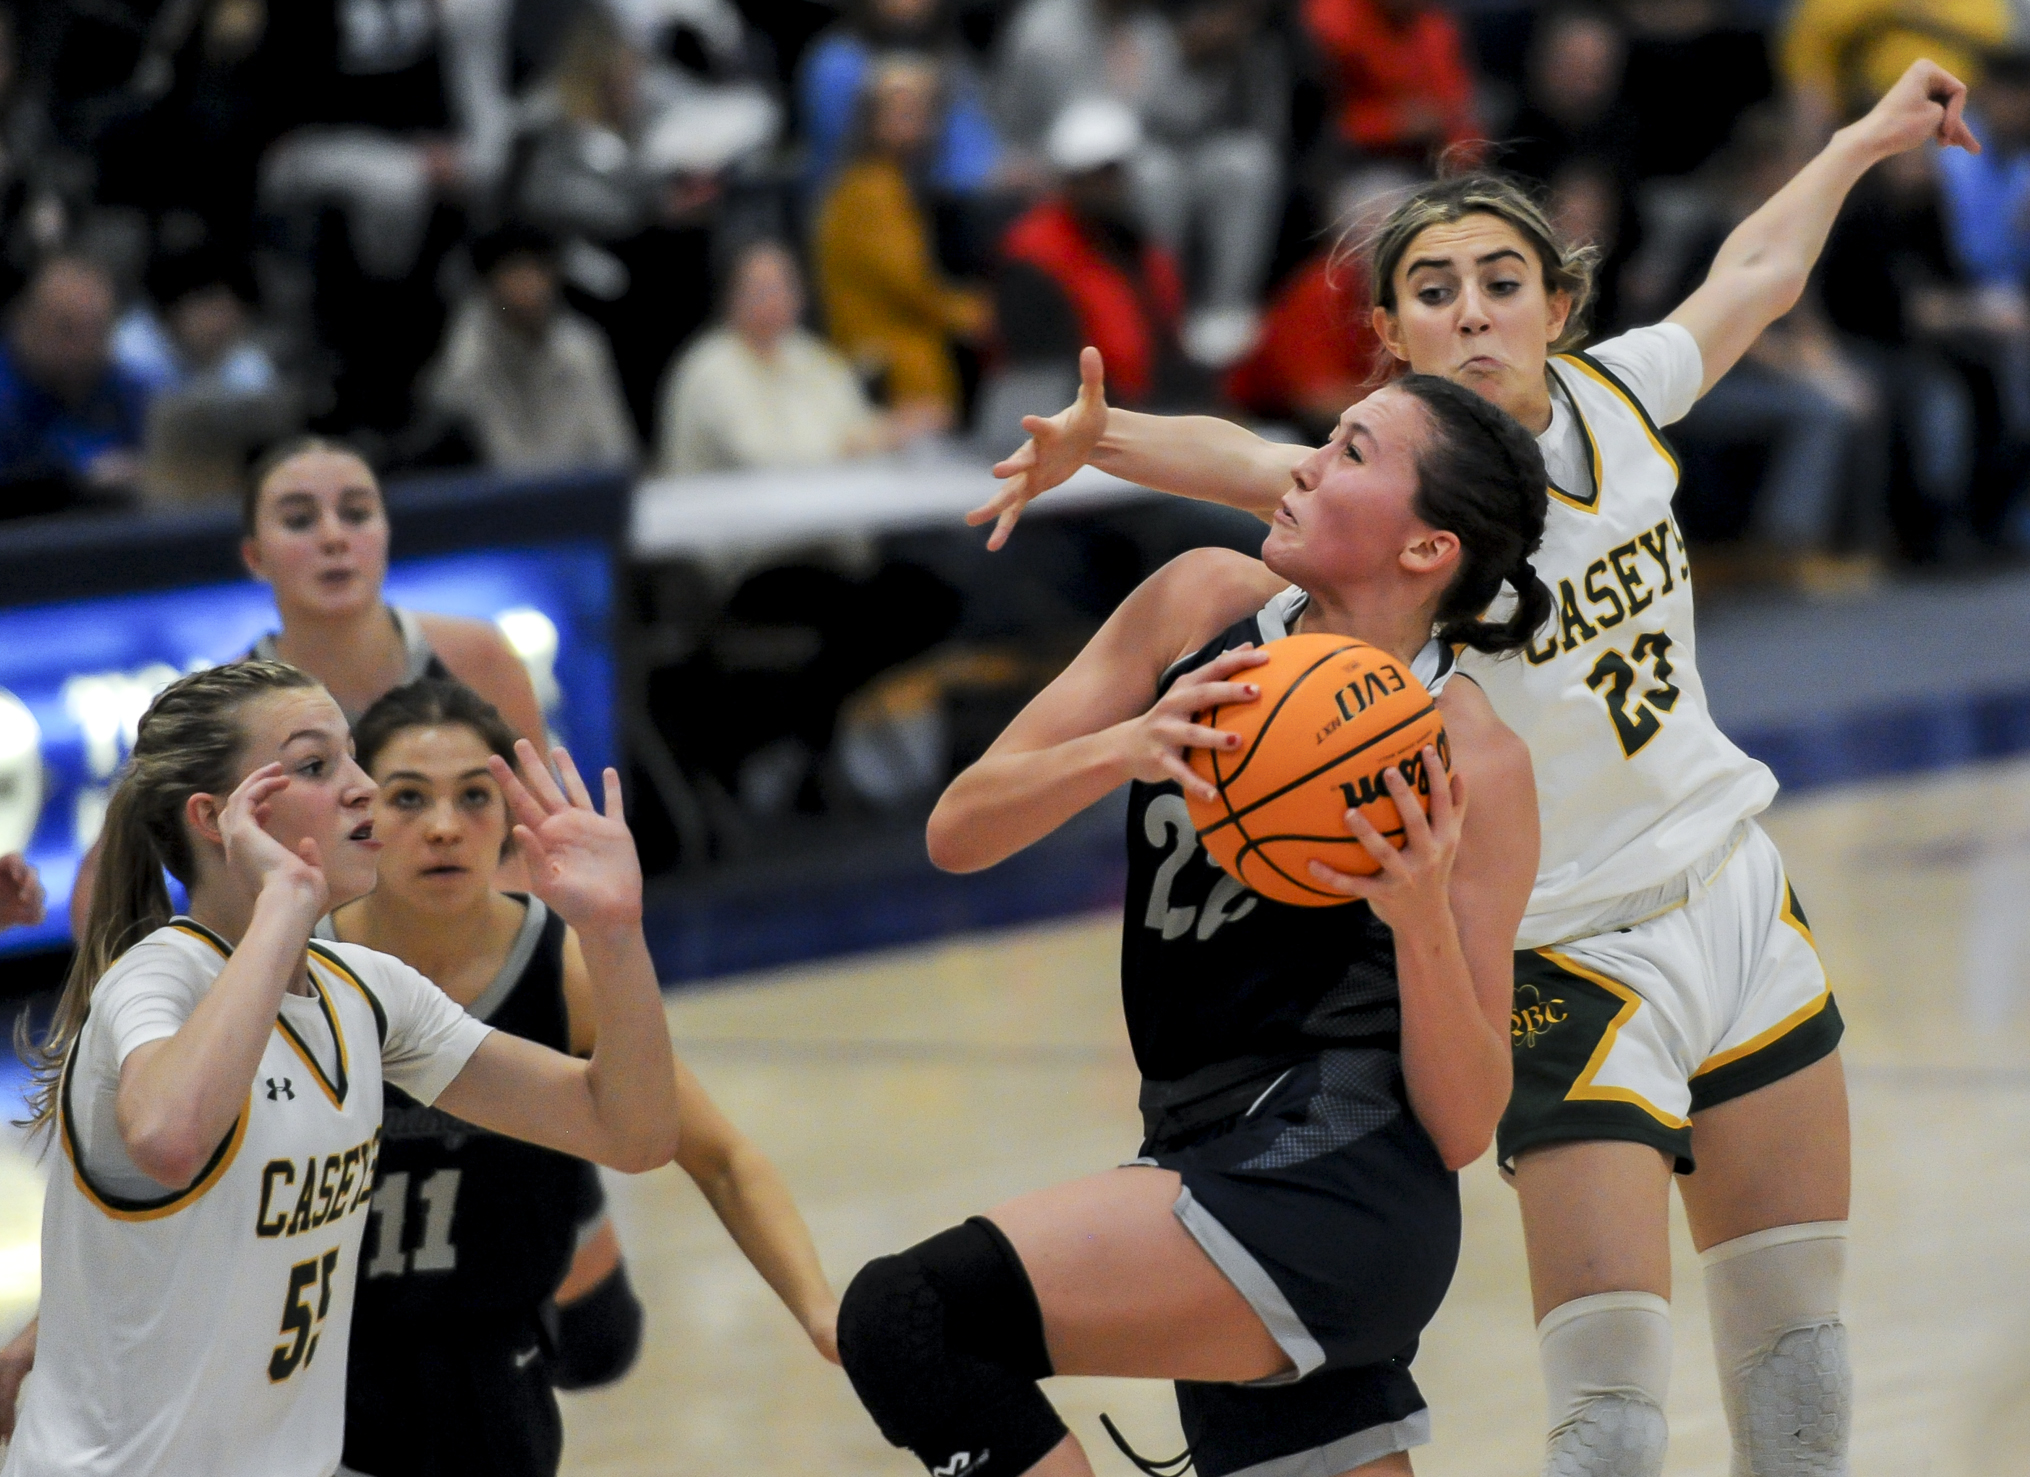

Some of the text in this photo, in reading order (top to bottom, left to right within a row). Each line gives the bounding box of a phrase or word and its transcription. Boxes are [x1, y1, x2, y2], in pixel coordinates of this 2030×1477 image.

[1315, 715, 1342, 746] NXT
[1335, 665, 1406, 722] EVO
[1583, 629, 1681, 761] 23
[368, 1168, 463, 1280] 11
